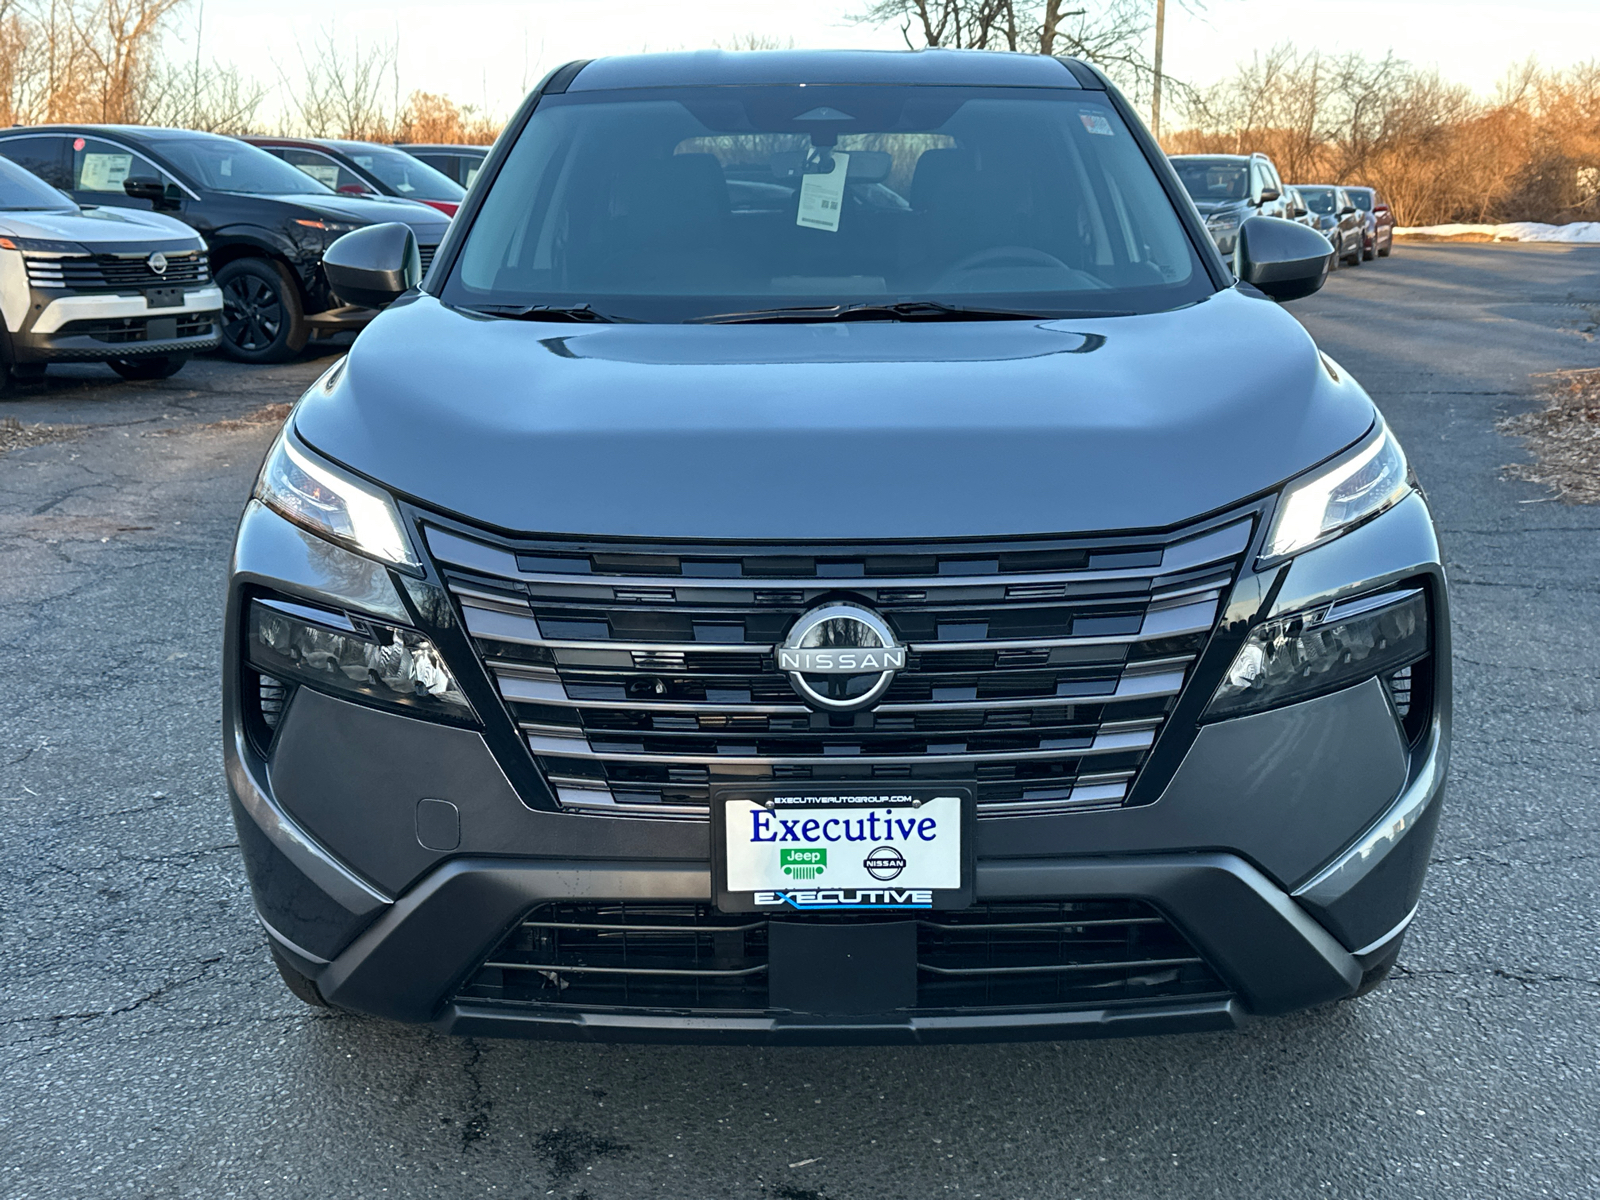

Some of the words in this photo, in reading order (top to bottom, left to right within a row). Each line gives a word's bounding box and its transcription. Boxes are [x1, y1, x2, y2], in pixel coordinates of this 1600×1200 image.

[782, 652, 901, 669] NISSAN
[774, 796, 912, 804] EXECUTIVEAUTOGROUP.COM
[750, 809, 937, 842] Executive
[787, 850, 821, 863] Jeep
[754, 890, 932, 905] EXECUTIVE
